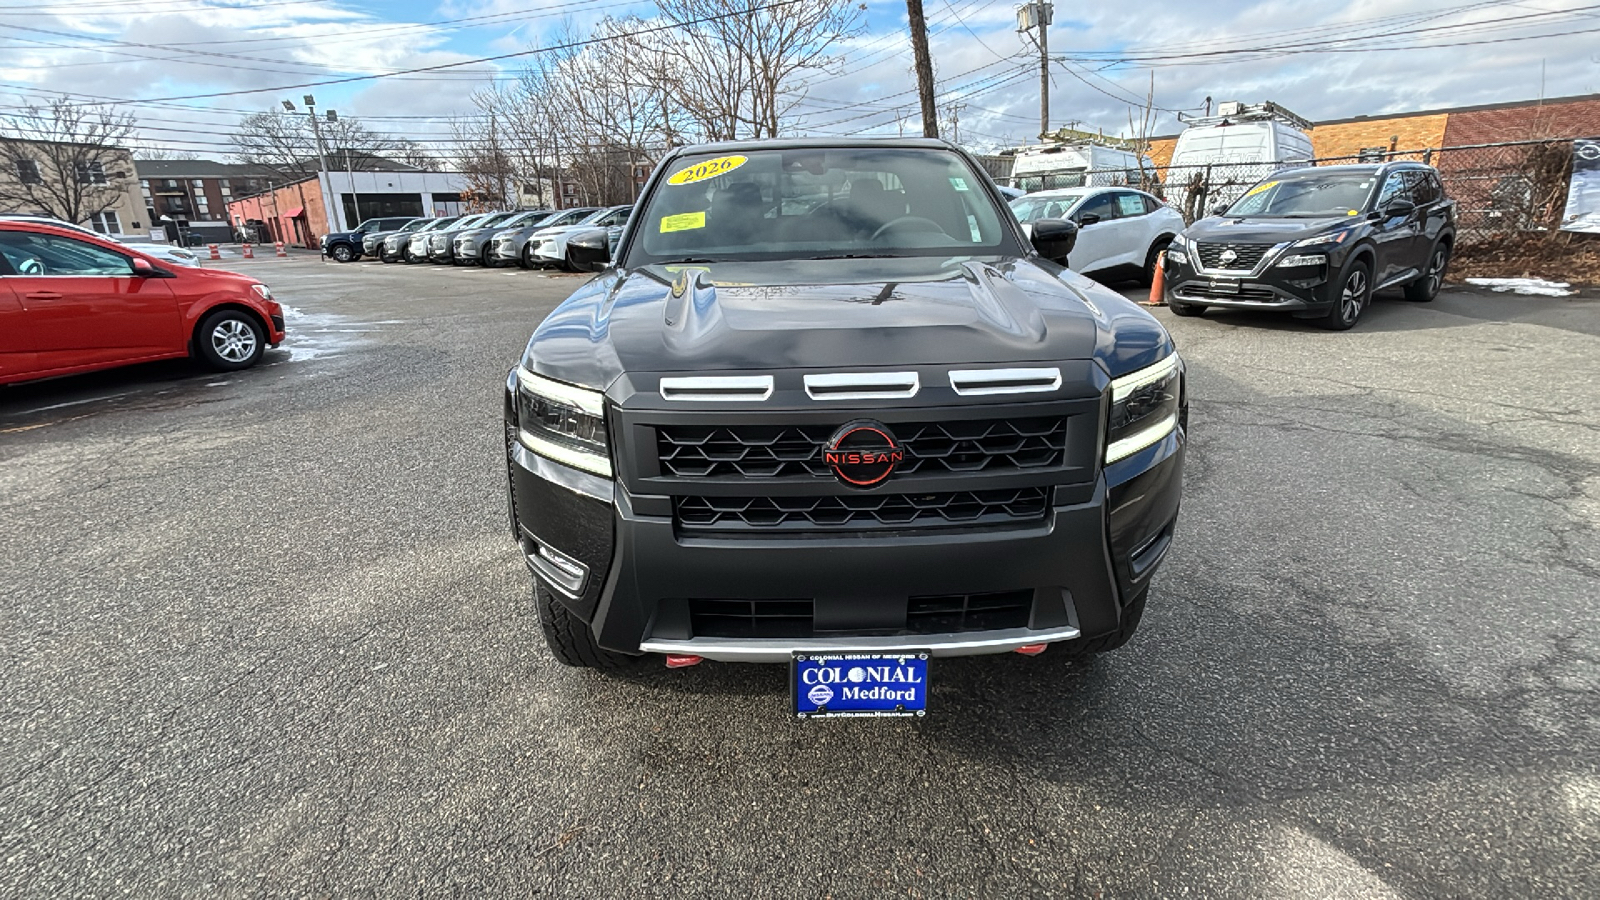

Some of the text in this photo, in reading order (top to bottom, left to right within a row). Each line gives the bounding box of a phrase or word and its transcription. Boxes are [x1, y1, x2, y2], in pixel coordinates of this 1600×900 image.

[683, 158, 732, 182] 2026
[826, 451, 902, 464] NISSAN
[803, 666, 921, 685] COLONIAL
[842, 686, 915, 700] Medford
